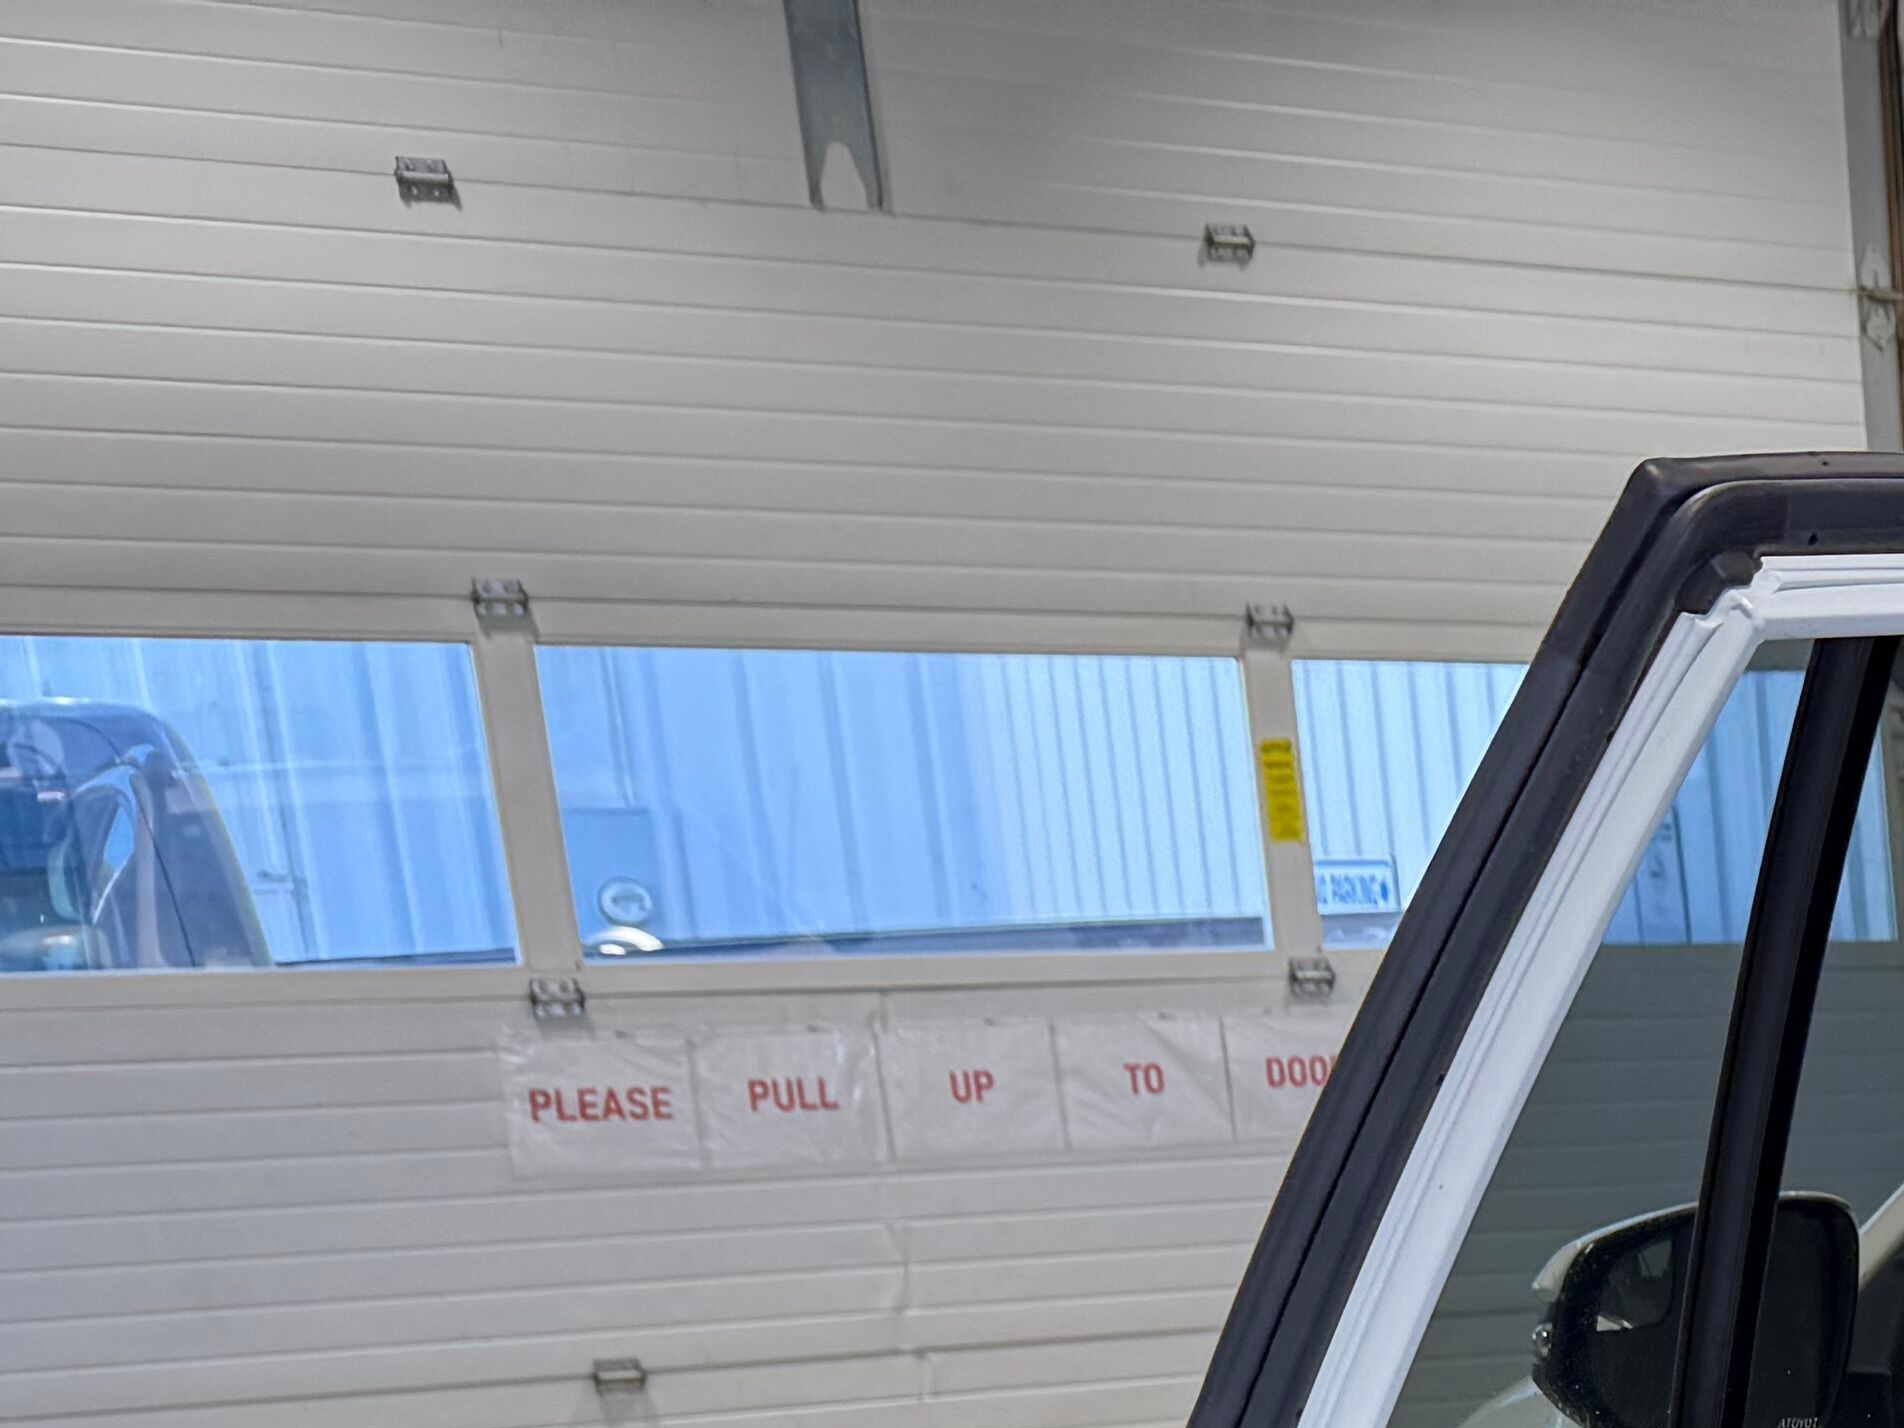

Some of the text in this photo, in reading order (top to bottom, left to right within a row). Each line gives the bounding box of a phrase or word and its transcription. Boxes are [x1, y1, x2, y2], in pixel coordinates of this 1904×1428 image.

[528, 1055, 1337, 1122] PLEASE PULL UP TO DOO
